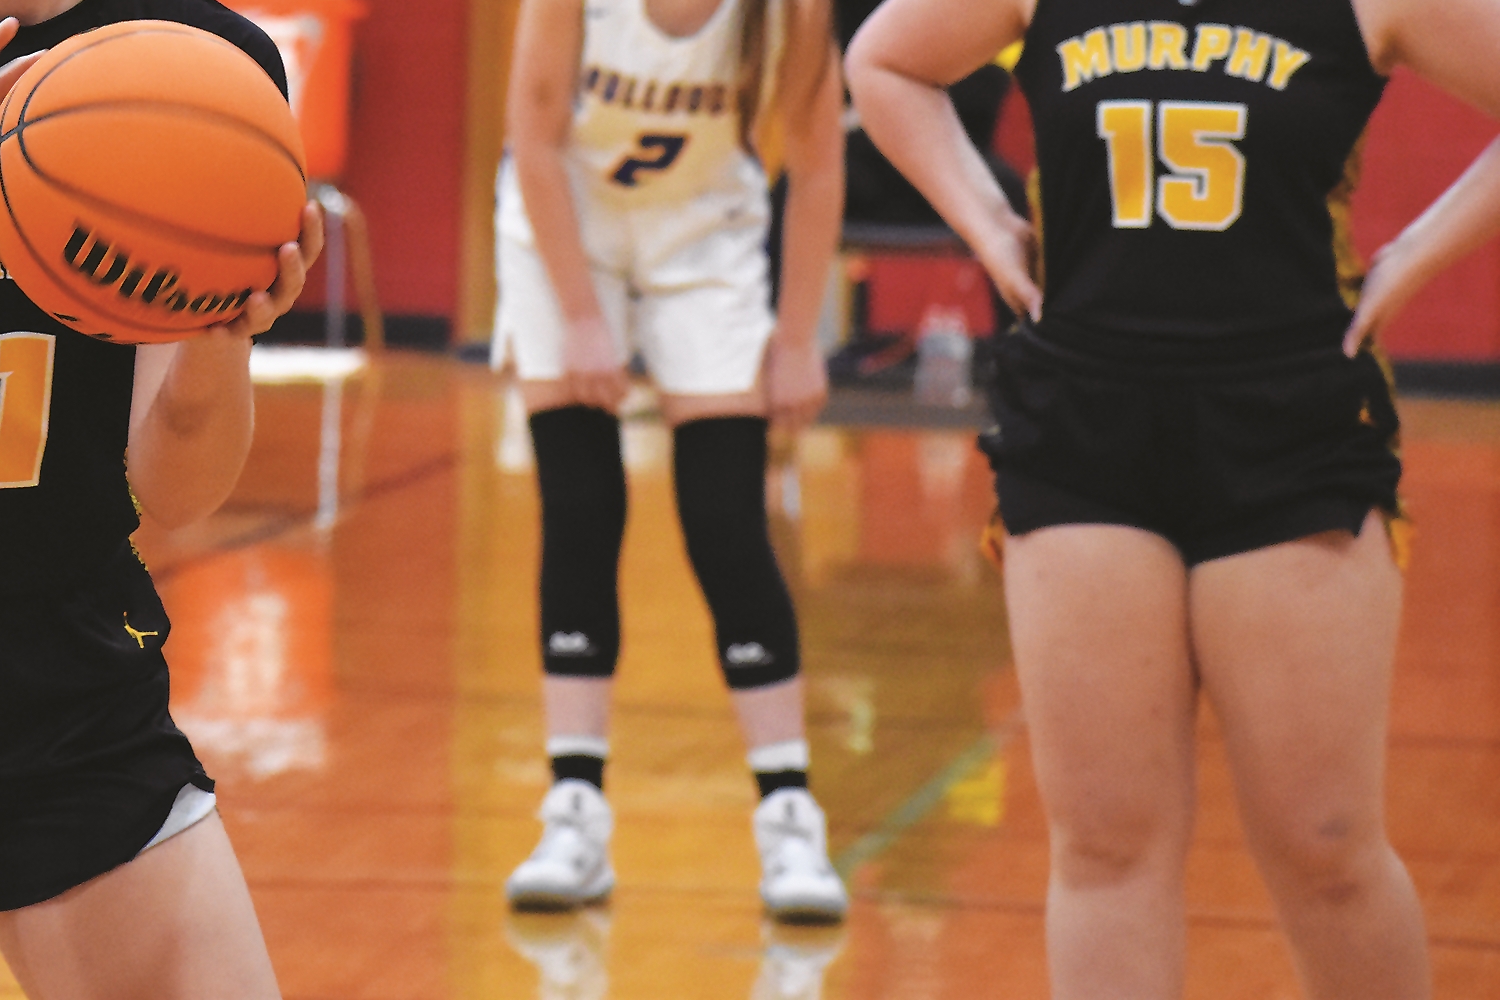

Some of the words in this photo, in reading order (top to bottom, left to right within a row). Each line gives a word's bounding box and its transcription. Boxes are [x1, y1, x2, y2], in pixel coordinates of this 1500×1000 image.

[1056, 20, 1311, 92] MURPHY
[610, 131, 690, 187] 2
[1096, 100, 1248, 231] 15
